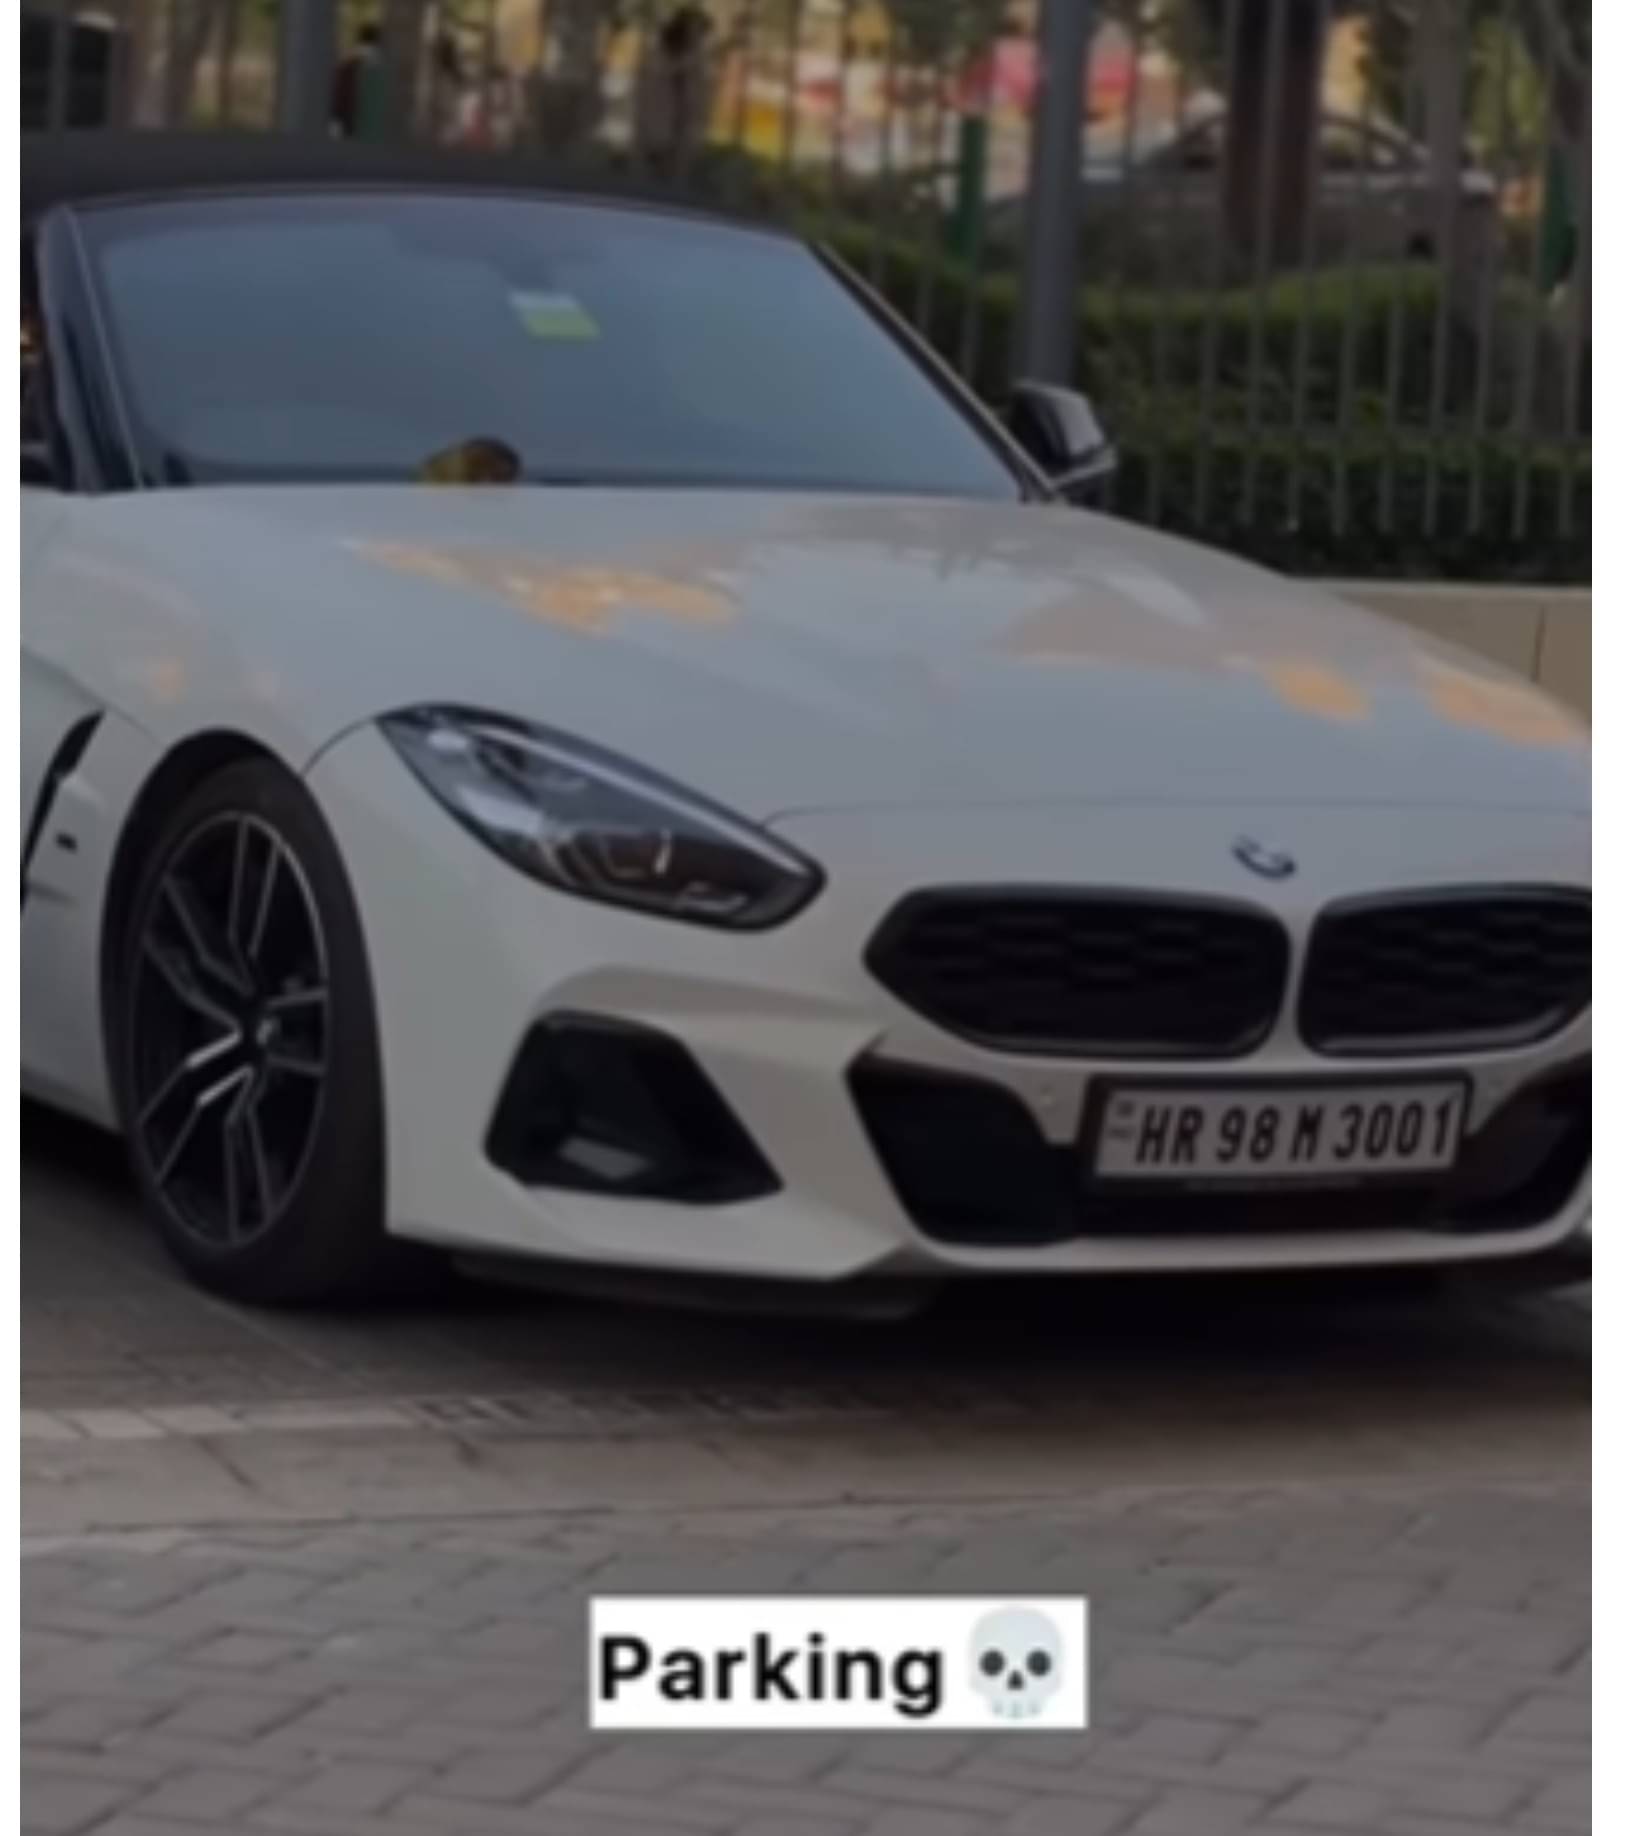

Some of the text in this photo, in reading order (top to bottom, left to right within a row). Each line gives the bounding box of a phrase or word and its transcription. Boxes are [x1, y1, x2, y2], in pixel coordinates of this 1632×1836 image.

[1135, 1106, 1203, 1164] HR
[1216, 1106, 1280, 1162] 98
[1334, 1100, 1453, 1160] 3001
